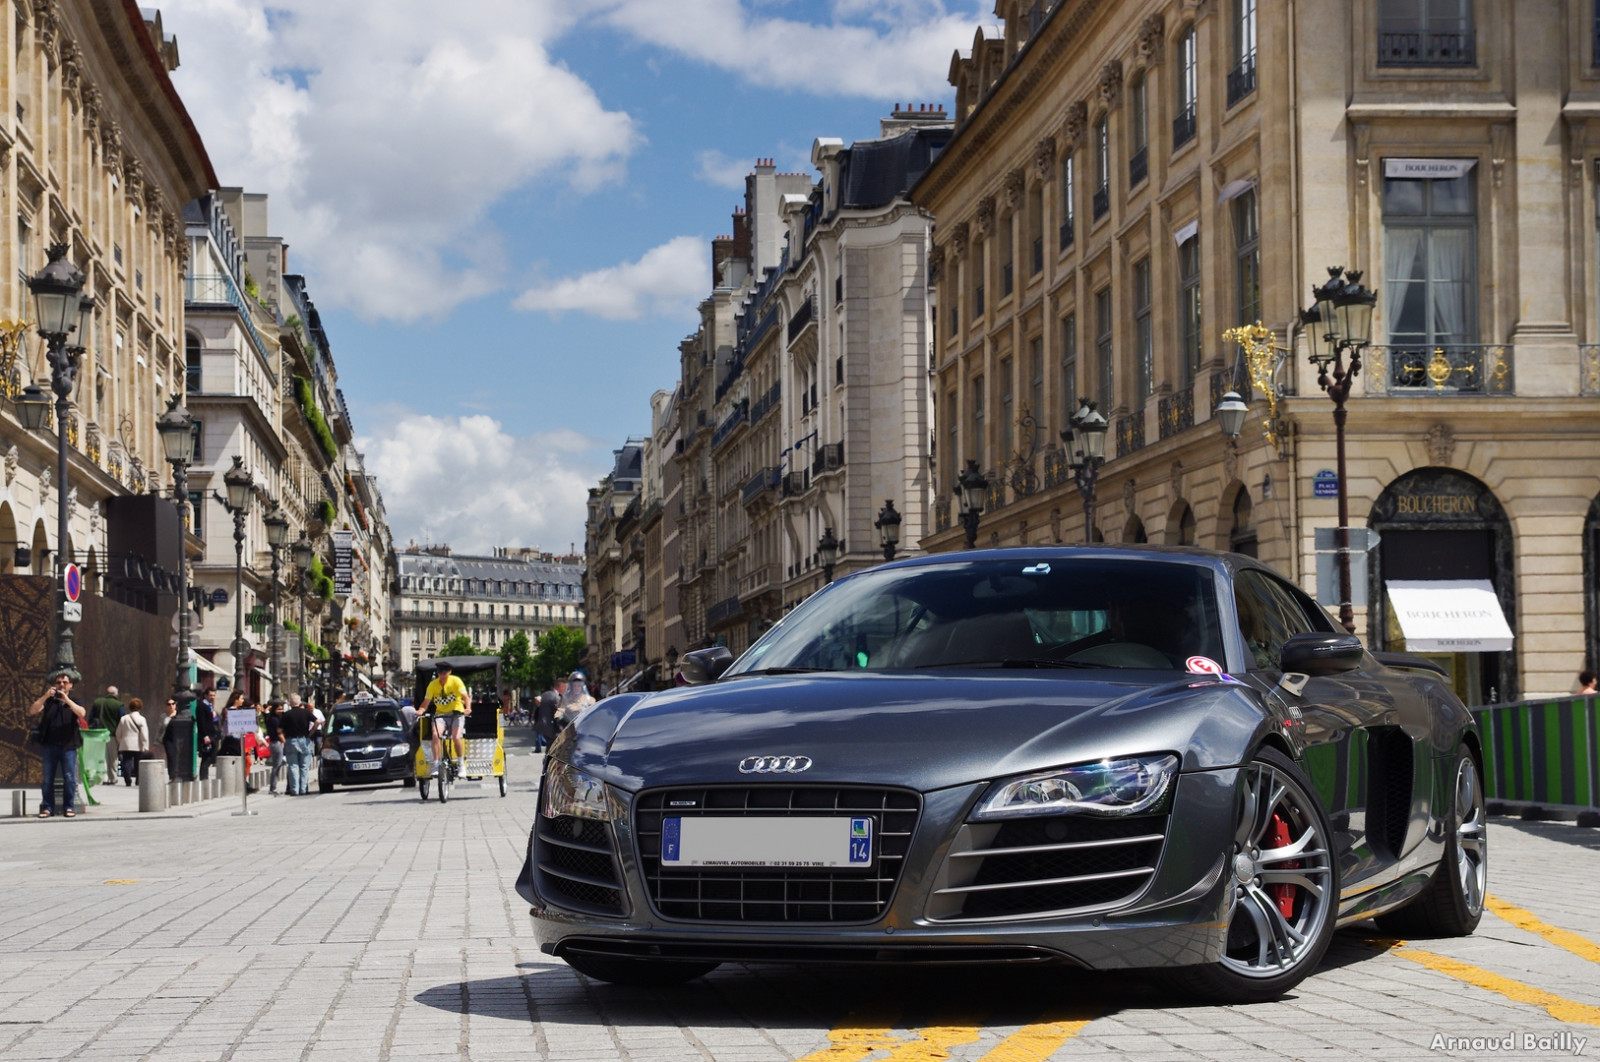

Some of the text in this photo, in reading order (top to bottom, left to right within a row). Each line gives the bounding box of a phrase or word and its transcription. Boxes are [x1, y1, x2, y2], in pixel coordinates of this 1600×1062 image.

[1398, 495, 1476, 514] BOUCHERON
[1406, 609, 1493, 619] BOUCHERON
[668, 844, 674, 854] F
[852, 843, 867, 859] 14
